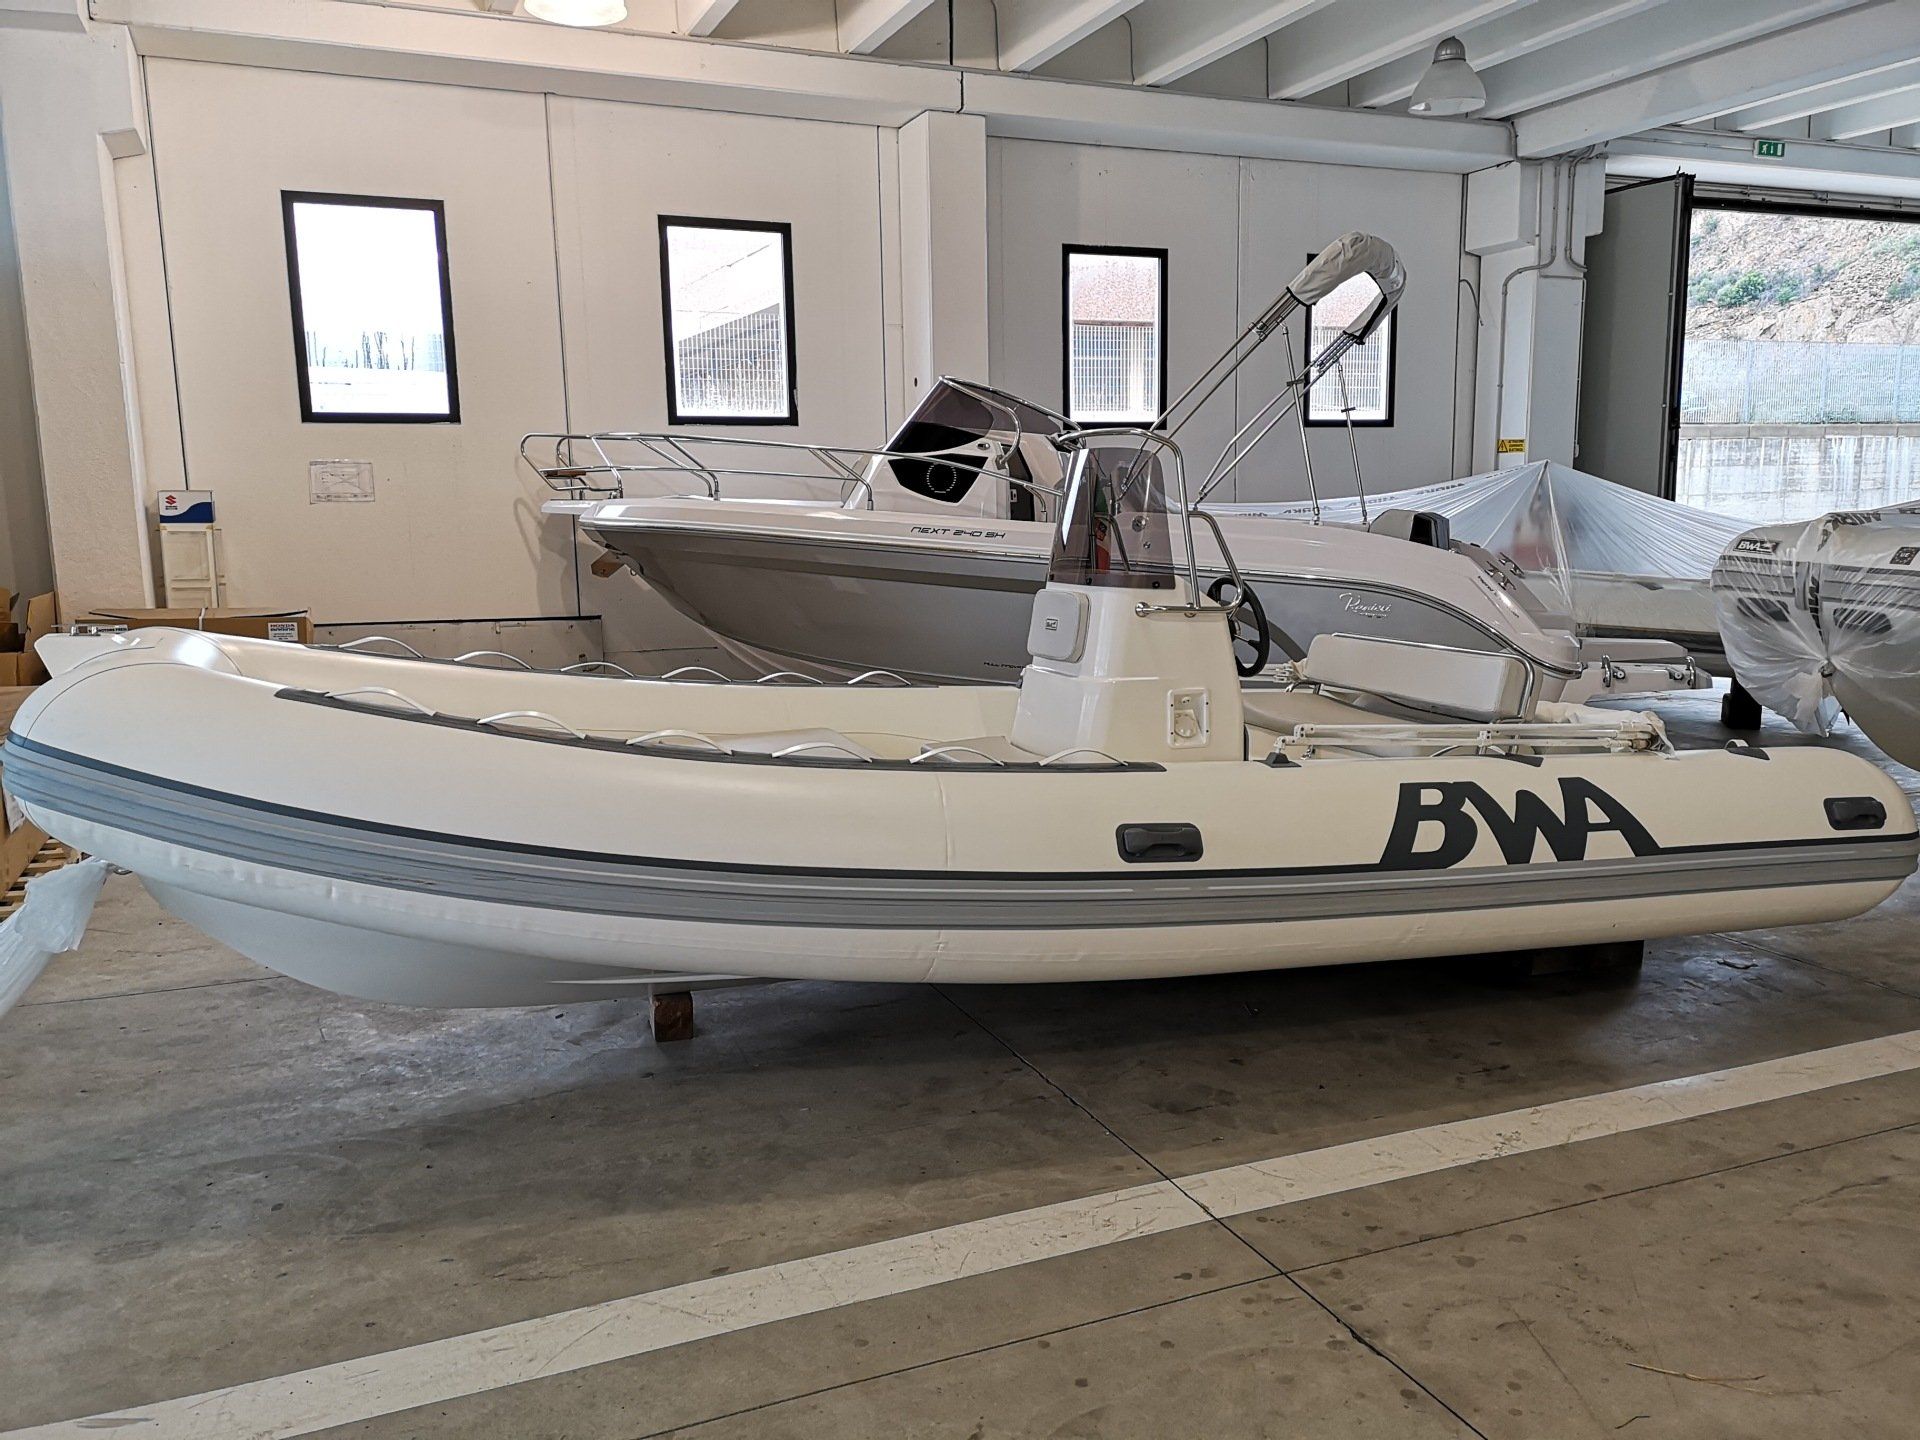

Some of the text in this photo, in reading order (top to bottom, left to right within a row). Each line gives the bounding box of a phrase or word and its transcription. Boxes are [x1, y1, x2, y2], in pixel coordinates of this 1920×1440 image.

[911, 526, 1006, 539] NEXT 240 SH
[1737, 540, 1761, 551] BWA
[1379, 777, 1661, 870] BWA
